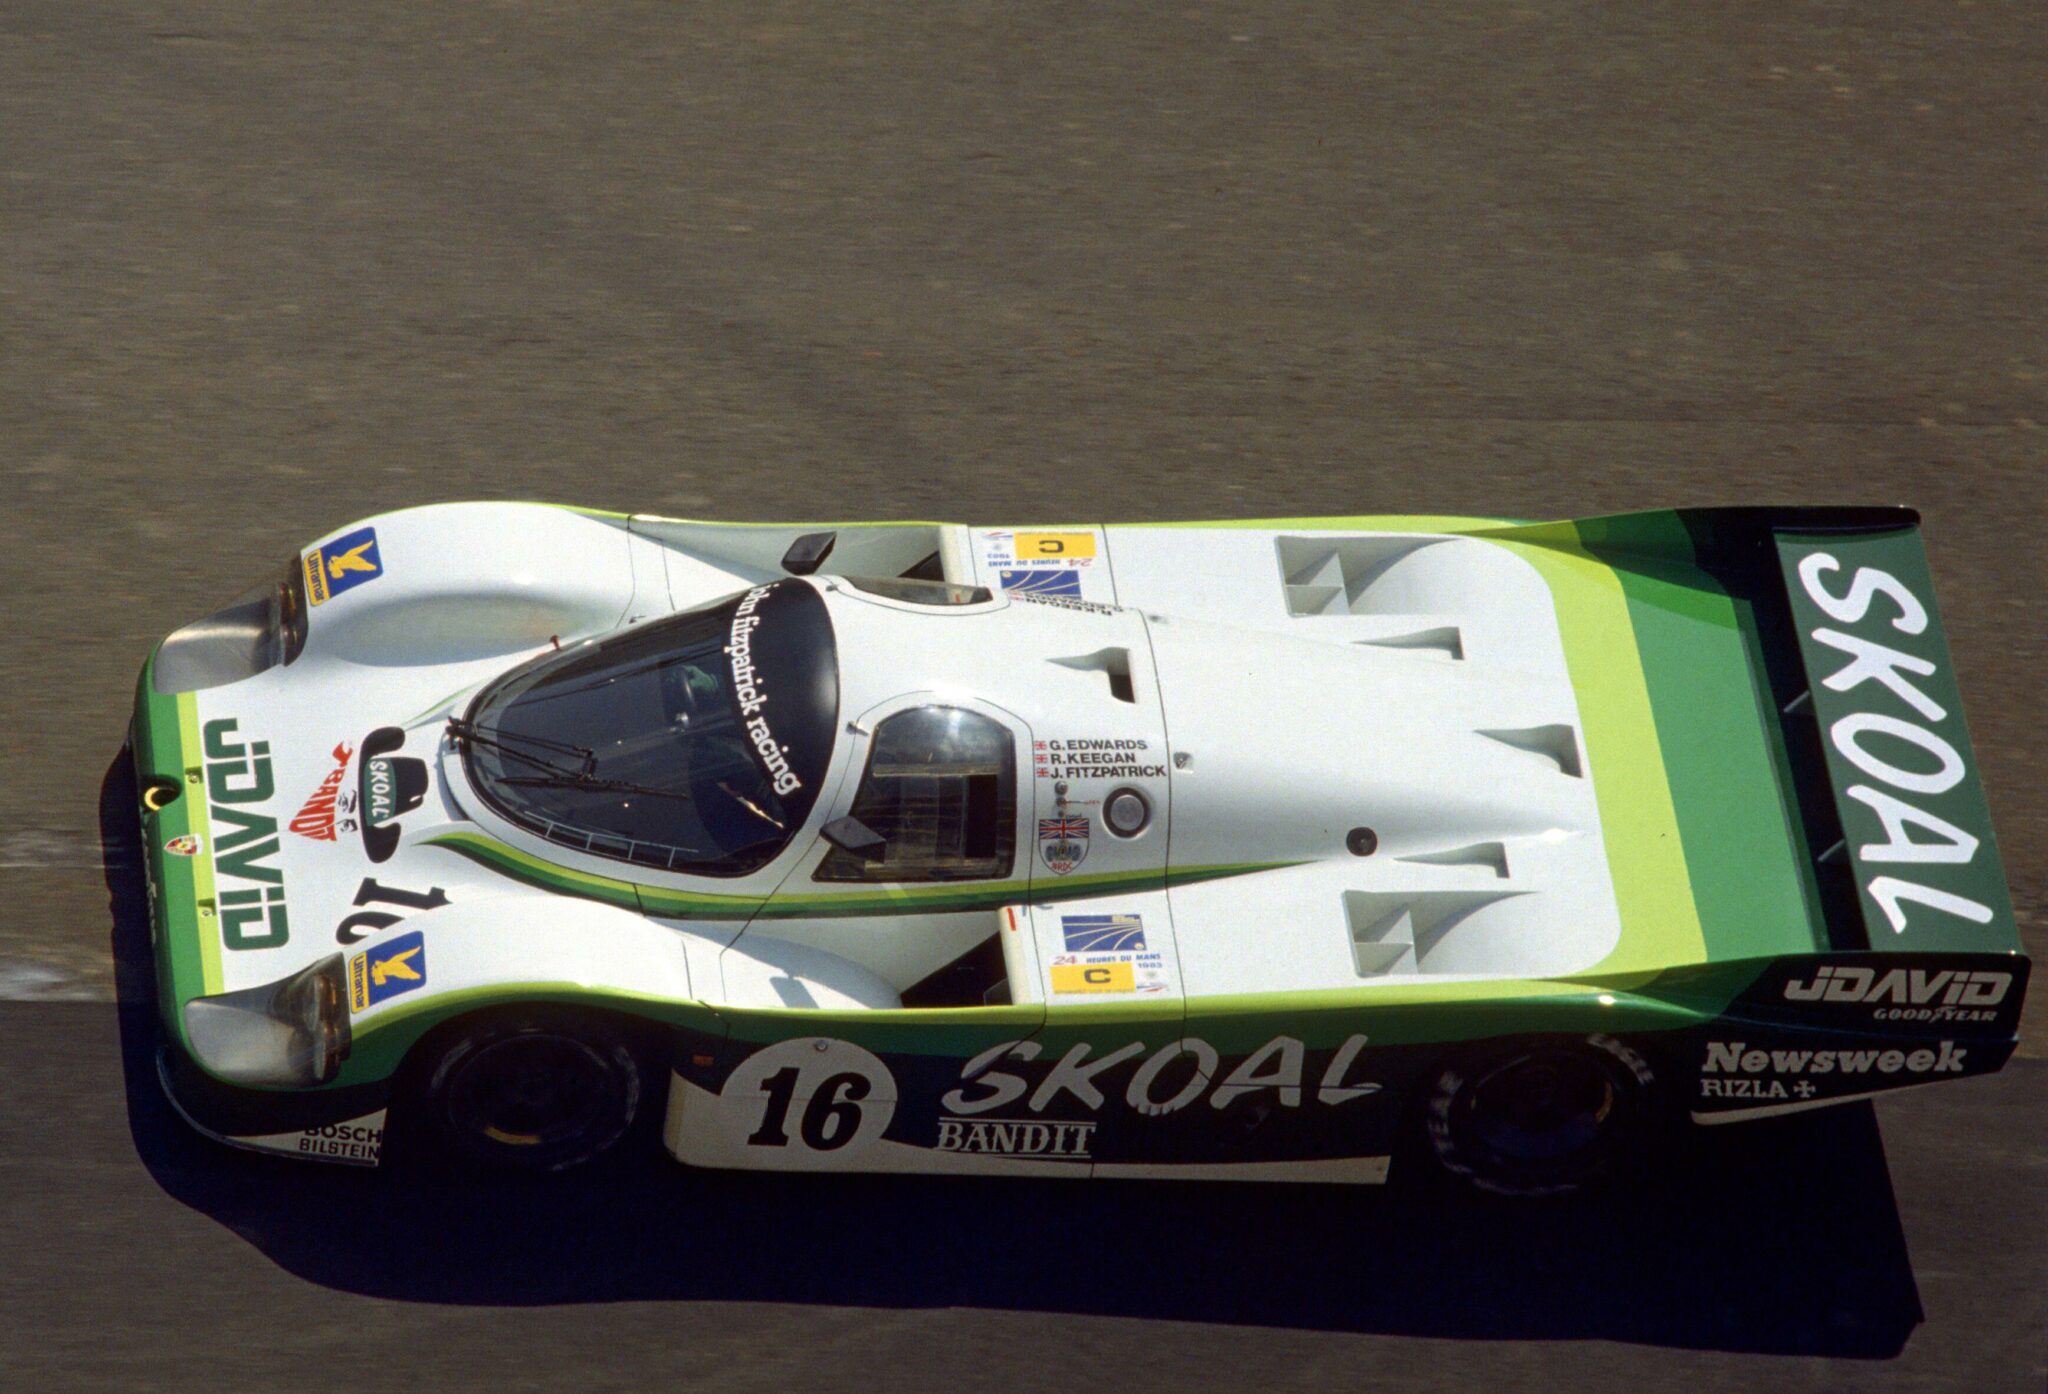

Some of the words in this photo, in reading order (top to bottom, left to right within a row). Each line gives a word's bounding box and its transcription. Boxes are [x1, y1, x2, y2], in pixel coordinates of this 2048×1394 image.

[1039, 540, 1065, 553] C
[307, 552, 325, 601] Ultramar
[723, 616, 768, 716] fitzpatrick
[747, 716, 802, 796] racing
[1798, 552, 1994, 934] SKOAL
[369, 760, 391, 817] SKOAL
[1053, 955, 1078, 965] 24
[1086, 956, 1116, 964] HEURES
[1136, 953, 1161, 961] MANS
[1084, 968, 1112, 984] C
[353, 955, 365, 1008] Ultramar
[941, 1034, 1383, 1117] SKOAL
[1702, 1040, 1968, 1074] Newsweek
[747, 1066, 872, 1151] 16
[299, 1138, 381, 1159] BILSTEIN
[304, 1123, 382, 1143] BOSCH
[937, 1120, 1096, 1155] BANDIT
